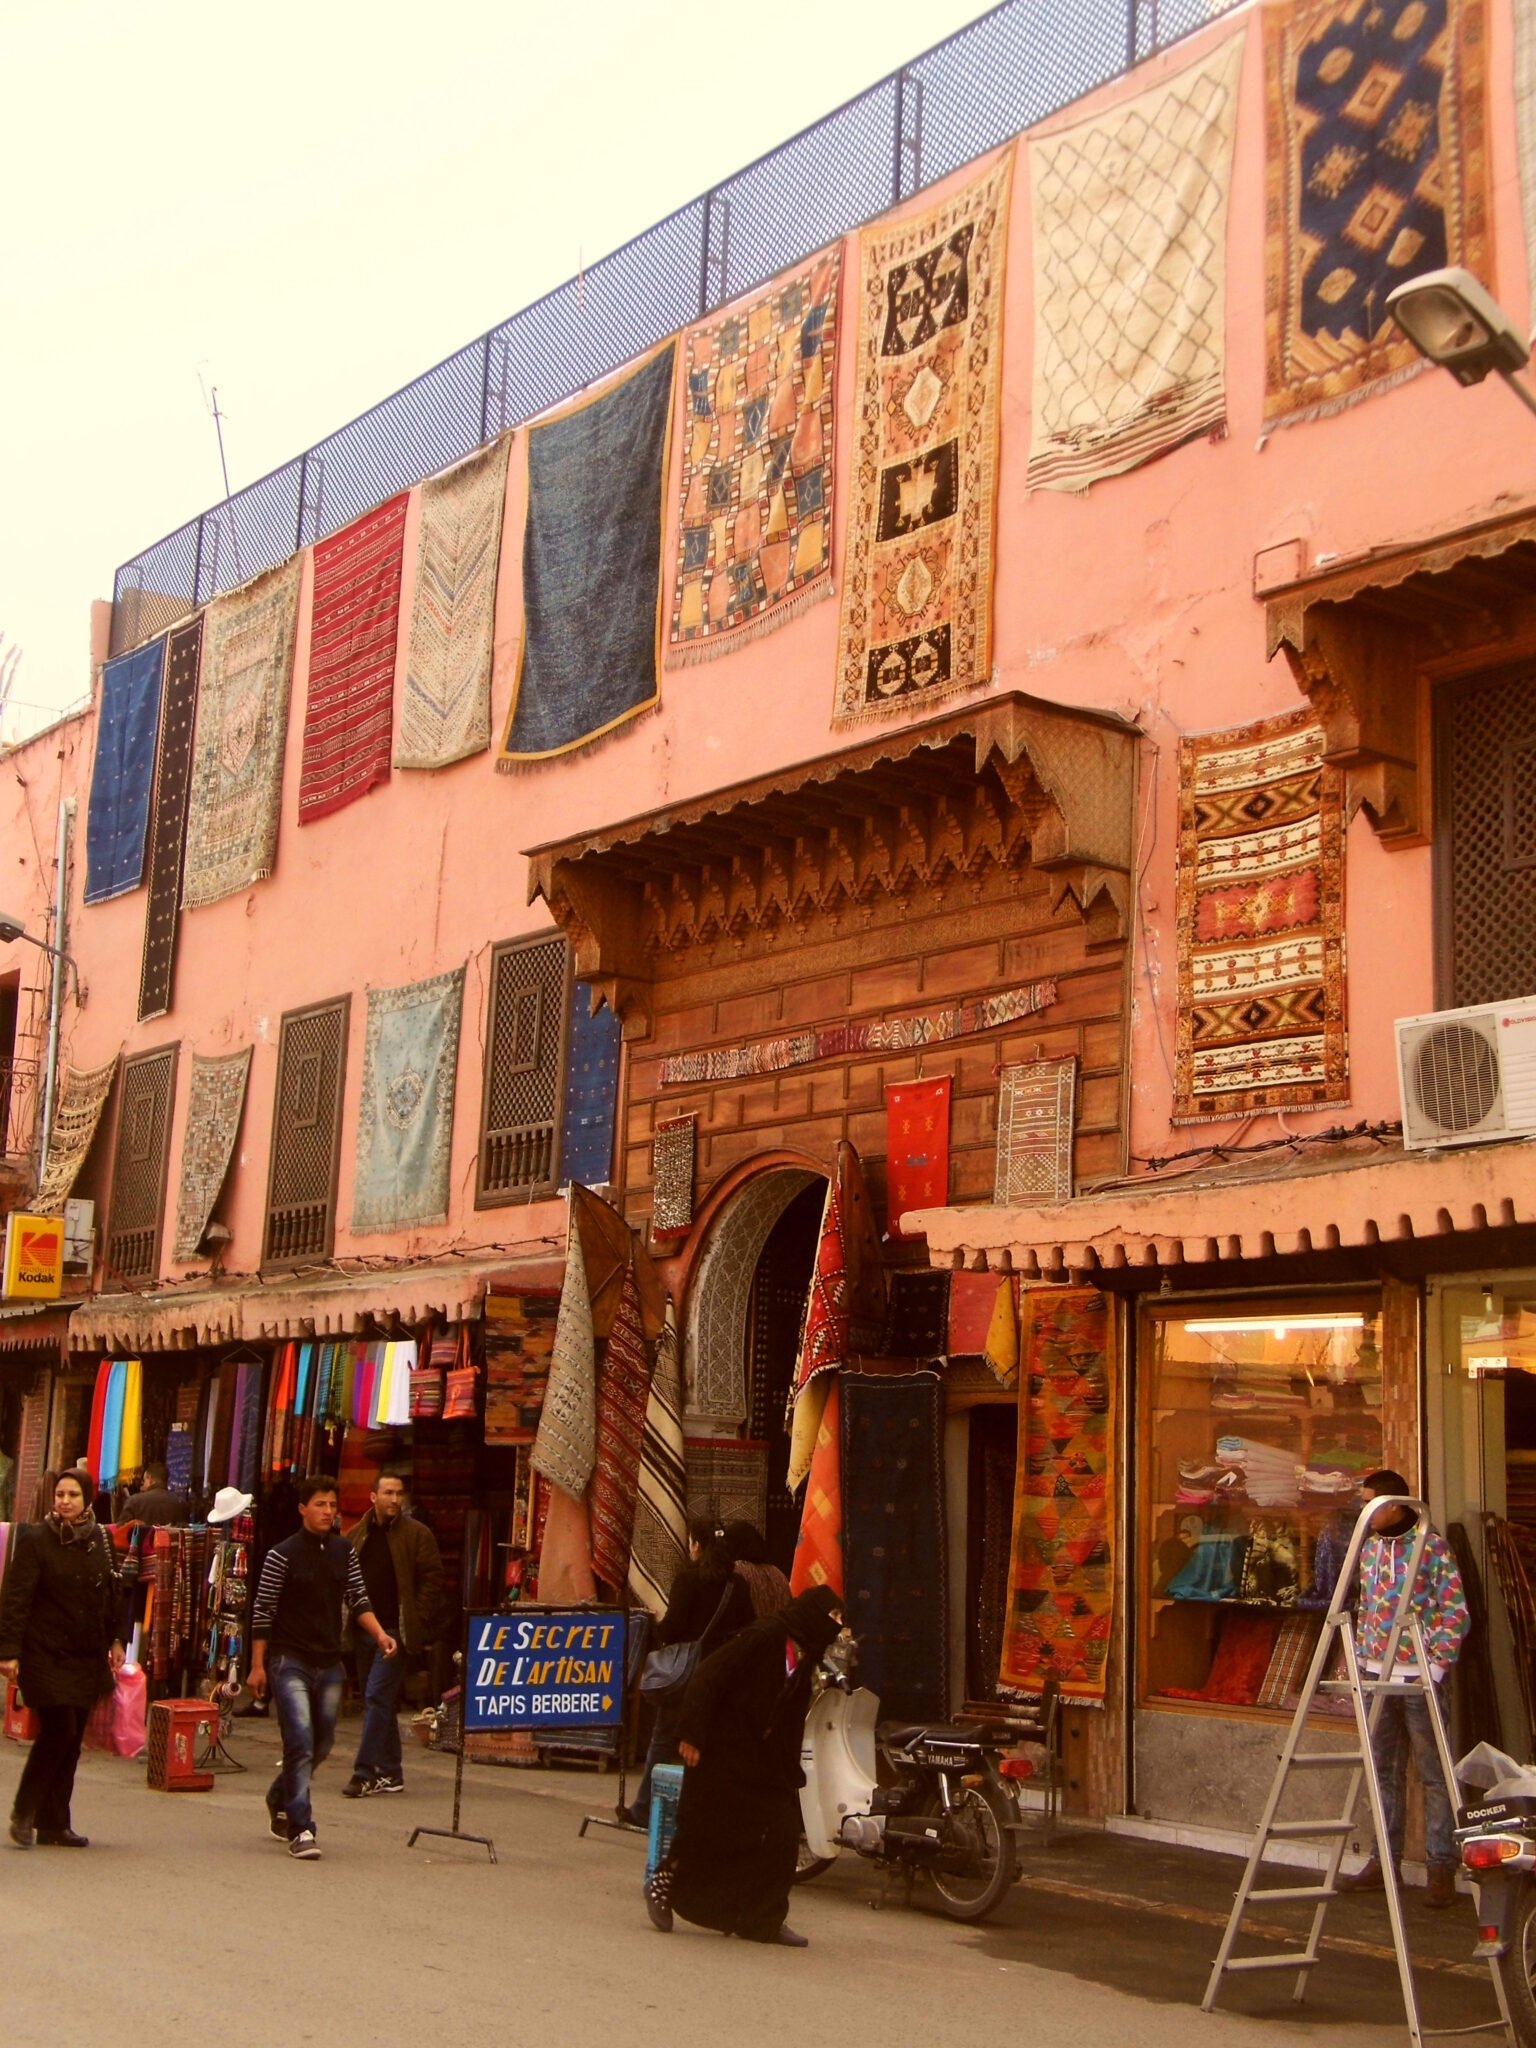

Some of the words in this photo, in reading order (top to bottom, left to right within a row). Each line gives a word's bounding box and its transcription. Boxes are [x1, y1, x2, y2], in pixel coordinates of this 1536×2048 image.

[18, 1271, 55, 1283] Kodak
[475, 1695, 526, 1715] TAPIS
[532, 1693, 600, 1714] BERBERE
[928, 1754, 953, 1766] YAMAHA
[1466, 1804, 1507, 1819] DOCKER
